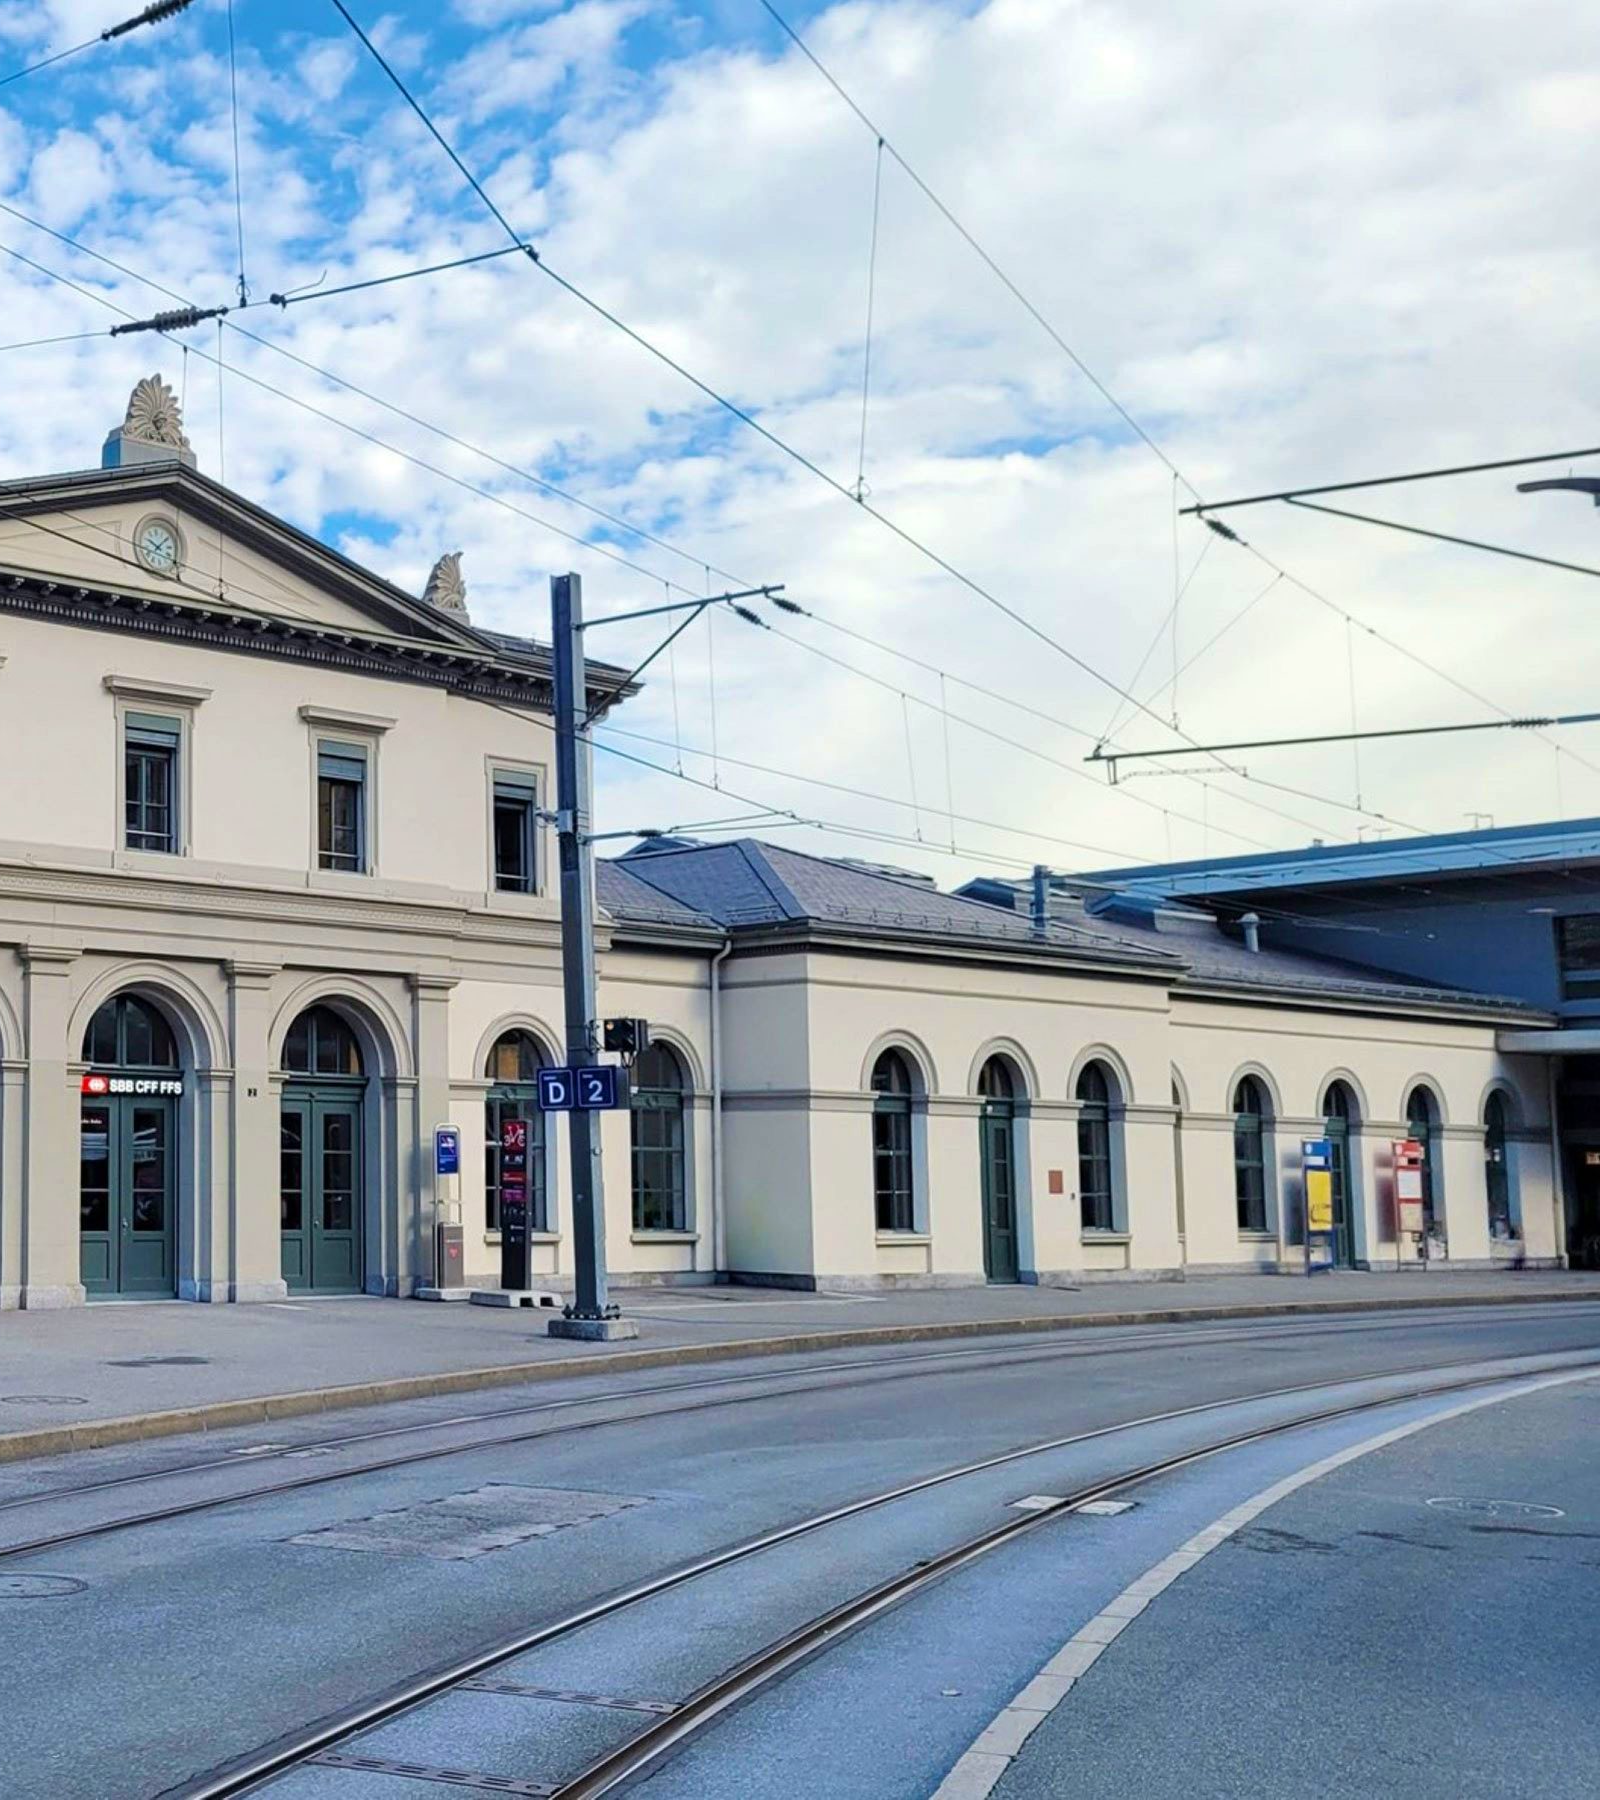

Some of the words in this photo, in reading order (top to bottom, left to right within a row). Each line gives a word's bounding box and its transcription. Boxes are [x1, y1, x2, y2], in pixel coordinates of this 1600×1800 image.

[109, 1079, 134, 1093] SBB
[135, 1080, 159, 1094] CFF
[160, 1081, 182, 1095] FFS
[549, 1082, 565, 1103] D
[588, 1080, 603, 1101] 2
